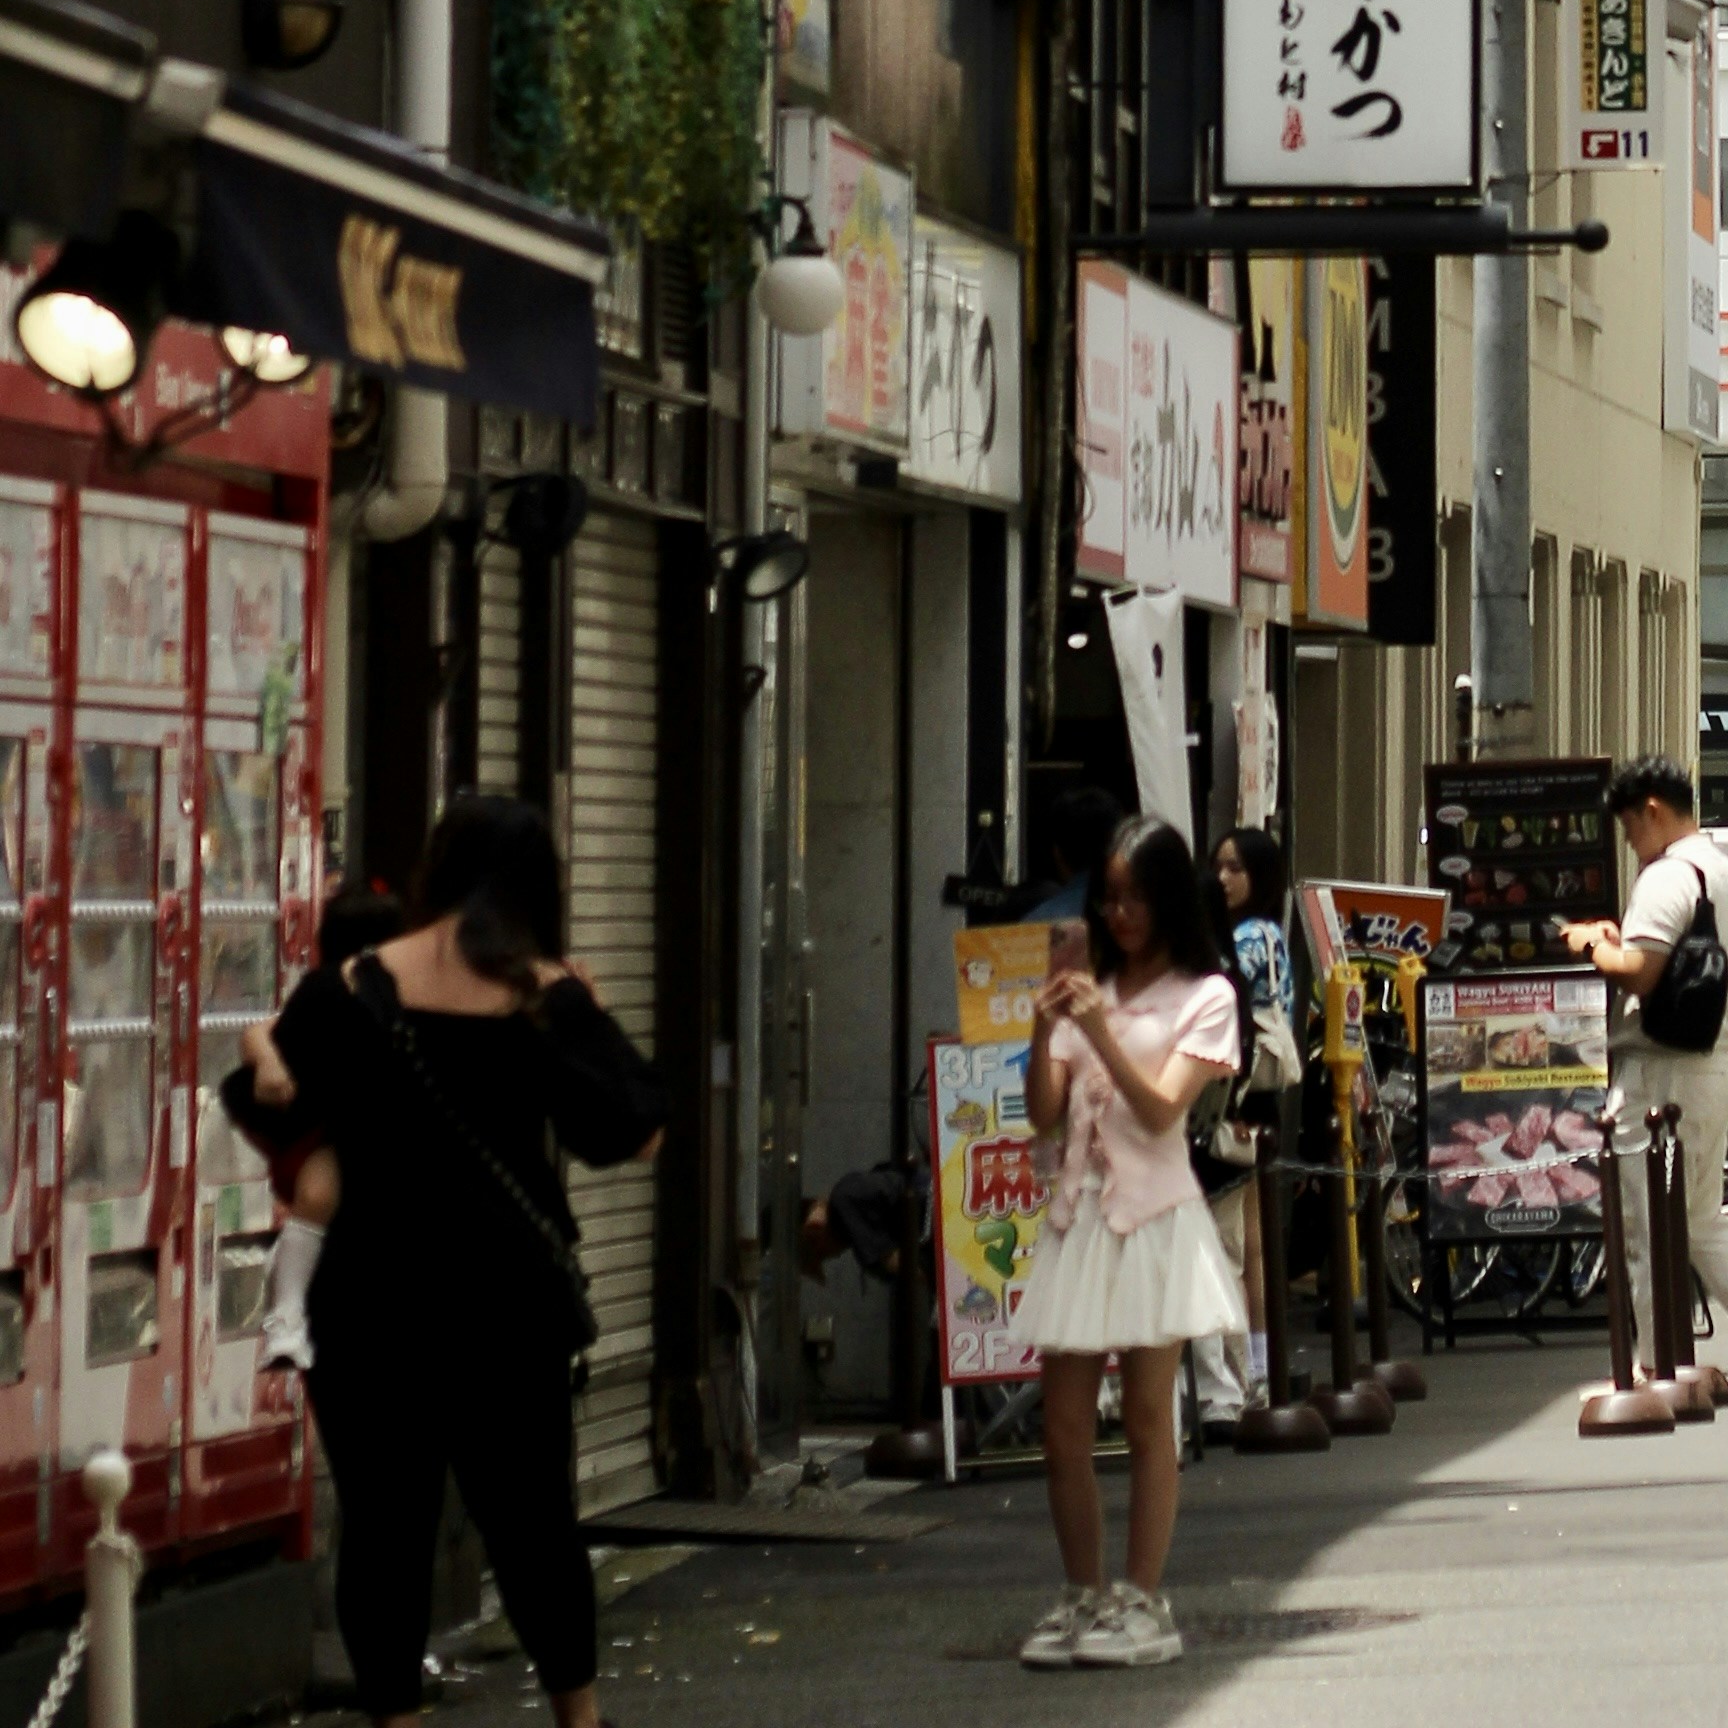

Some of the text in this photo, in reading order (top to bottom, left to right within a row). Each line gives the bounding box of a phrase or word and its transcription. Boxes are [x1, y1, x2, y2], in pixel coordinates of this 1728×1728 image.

[1622, 130, 1649, 159] 11
[942, 1047, 1000, 1090] 3F
[952, 1330, 1011, 1373] 2F
